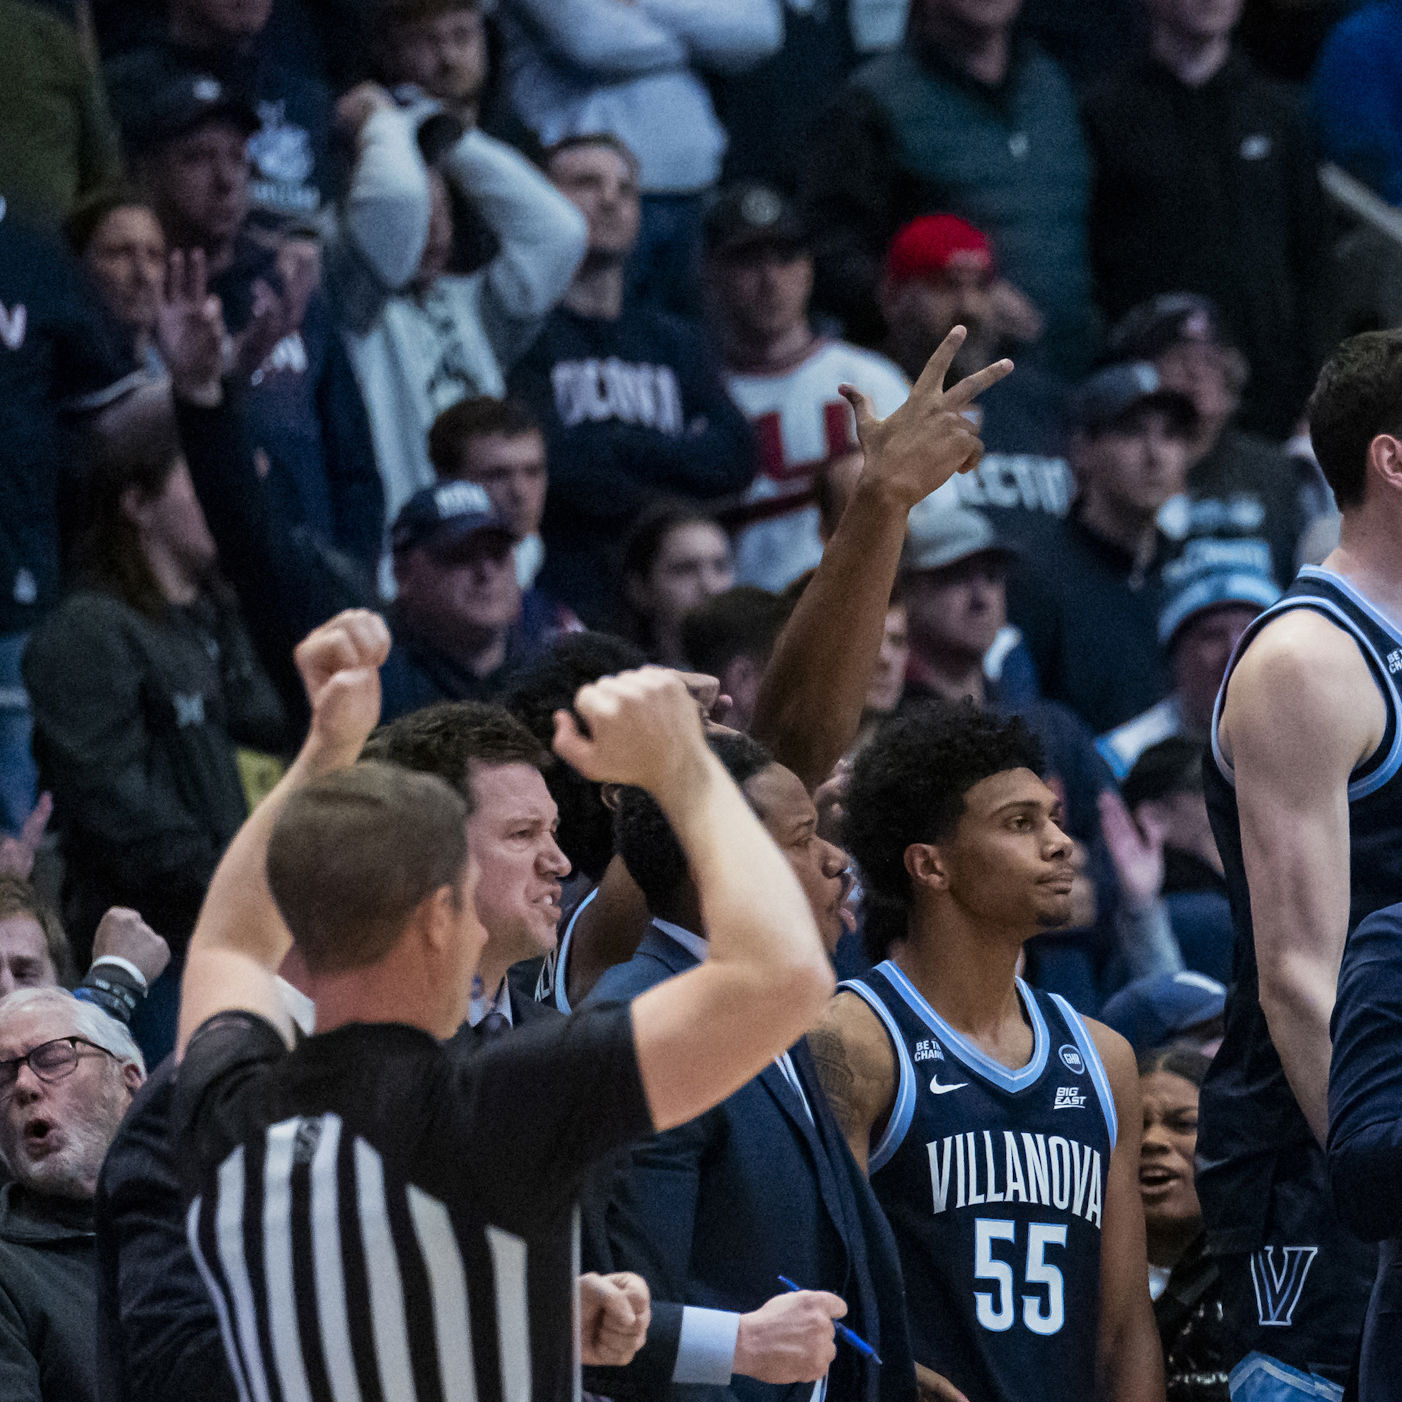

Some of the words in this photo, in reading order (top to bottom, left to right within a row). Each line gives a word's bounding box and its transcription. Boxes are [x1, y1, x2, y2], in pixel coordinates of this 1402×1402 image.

[915, 1040, 930, 1051] BE
[914, 1048, 945, 1062] CHAN
[1063, 1052, 1081, 1066] GHR
[1056, 1086, 1080, 1097] BIG
[1054, 1096, 1087, 1106] EAST
[926, 1130, 1102, 1230] VILLANOVA
[973, 1217, 1069, 1337] 55
